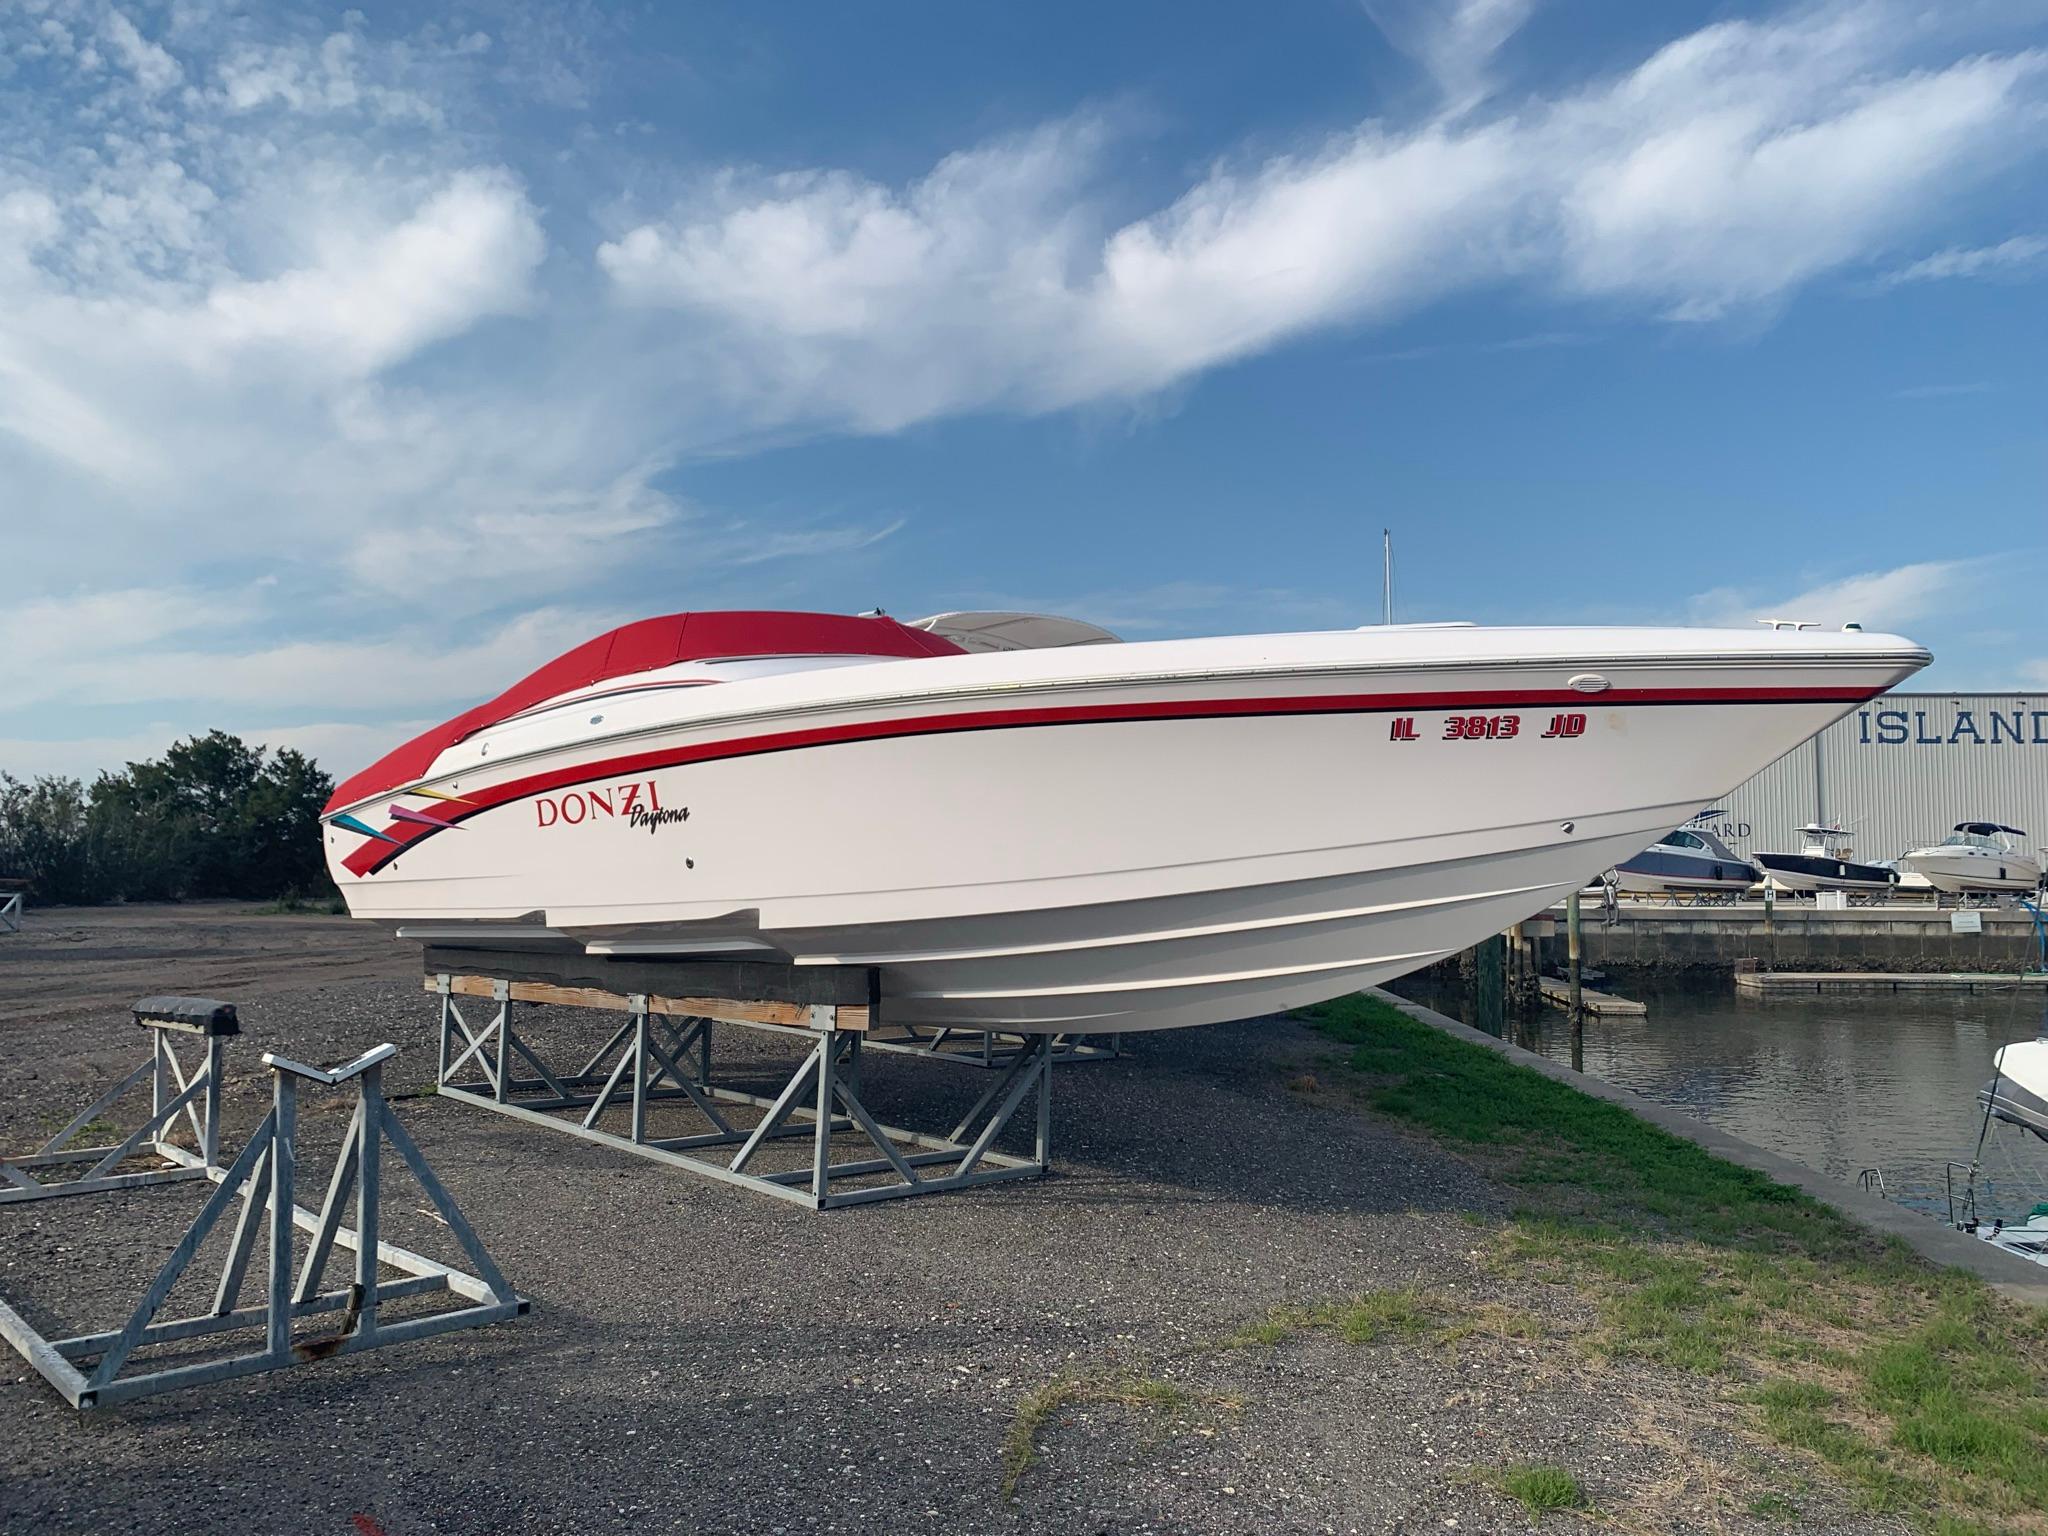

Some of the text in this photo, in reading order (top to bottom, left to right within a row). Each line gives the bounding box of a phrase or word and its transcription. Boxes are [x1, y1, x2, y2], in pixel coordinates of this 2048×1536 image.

[1390, 713, 1588, 741] IL 3813 JD
[535, 780, 662, 828] DONZI
[629, 803, 690, 835] Daytona
